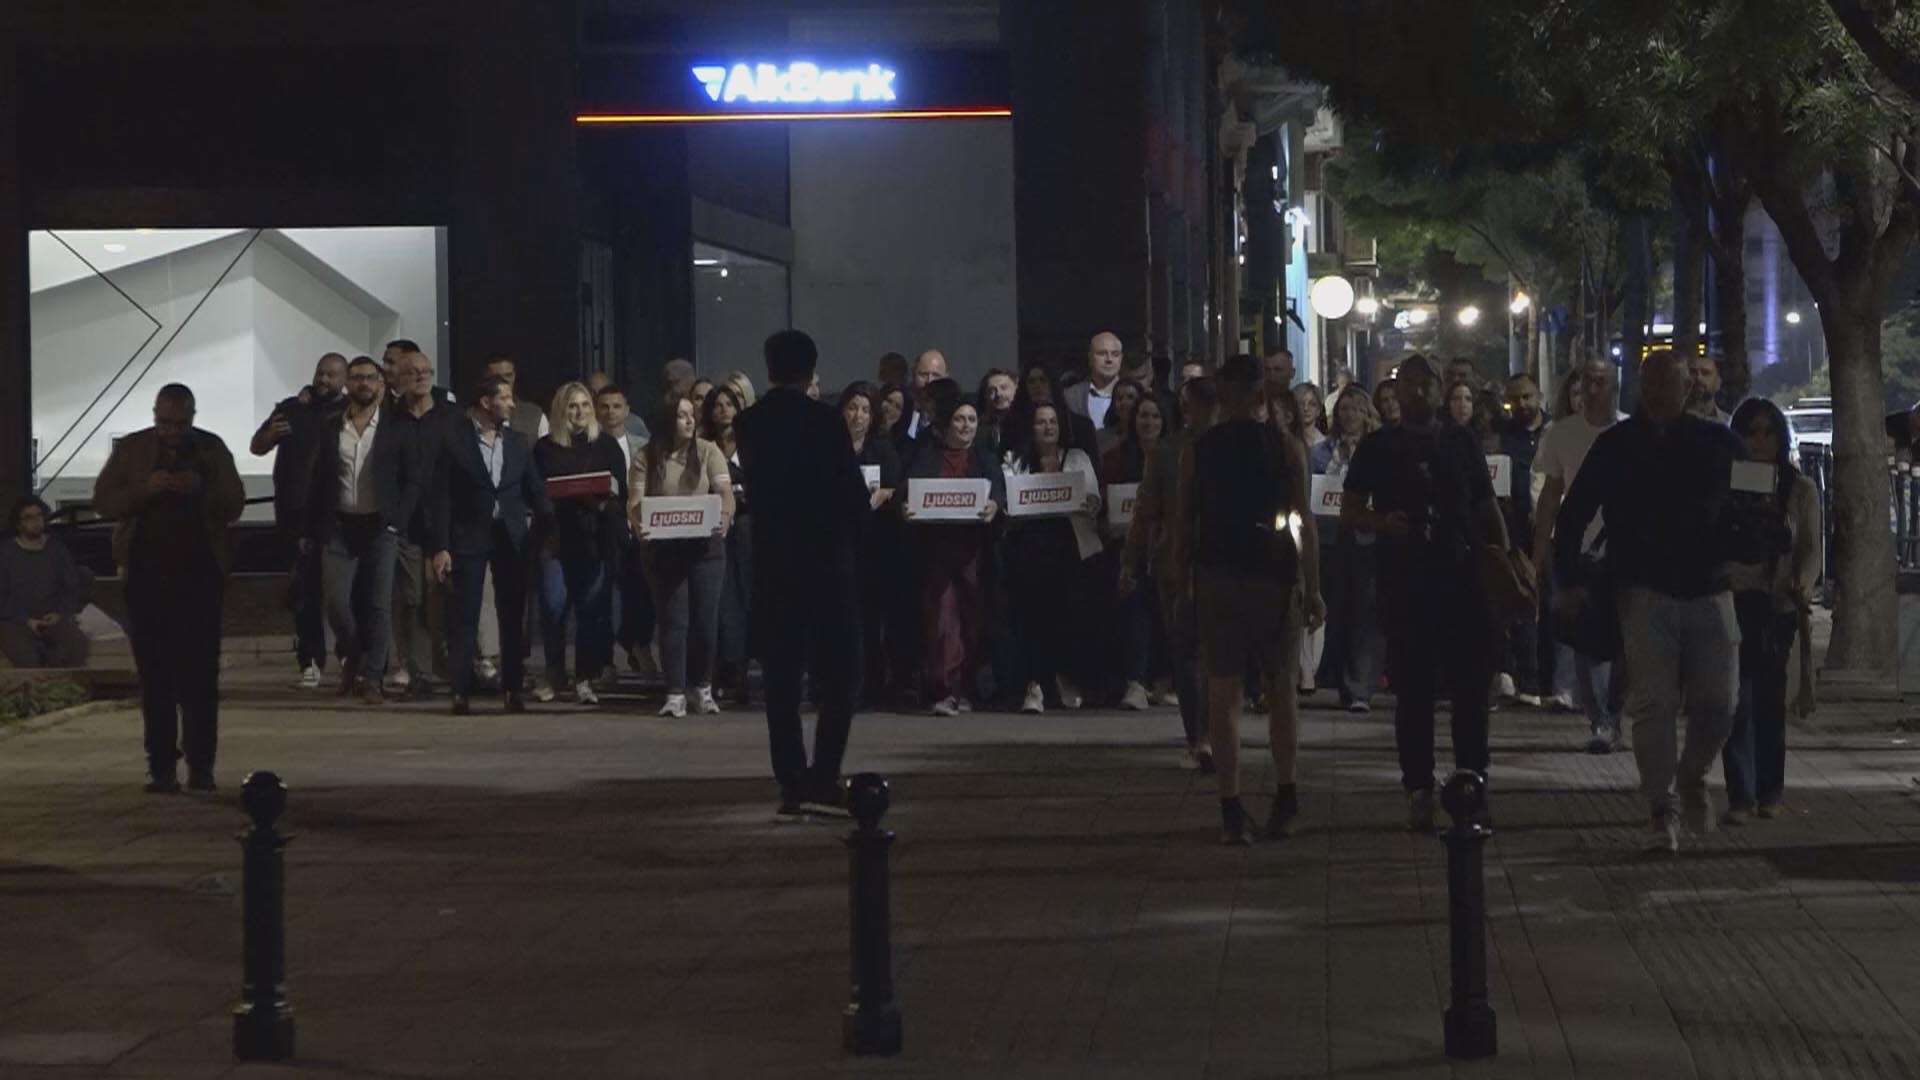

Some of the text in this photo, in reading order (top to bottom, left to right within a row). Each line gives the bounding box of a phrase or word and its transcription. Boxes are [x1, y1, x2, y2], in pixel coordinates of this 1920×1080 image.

[922, 492, 976, 508] LJUDSKI
[1019, 486, 1072, 504] LJUDSKI
[650, 510, 704, 527] LJUDSKI
